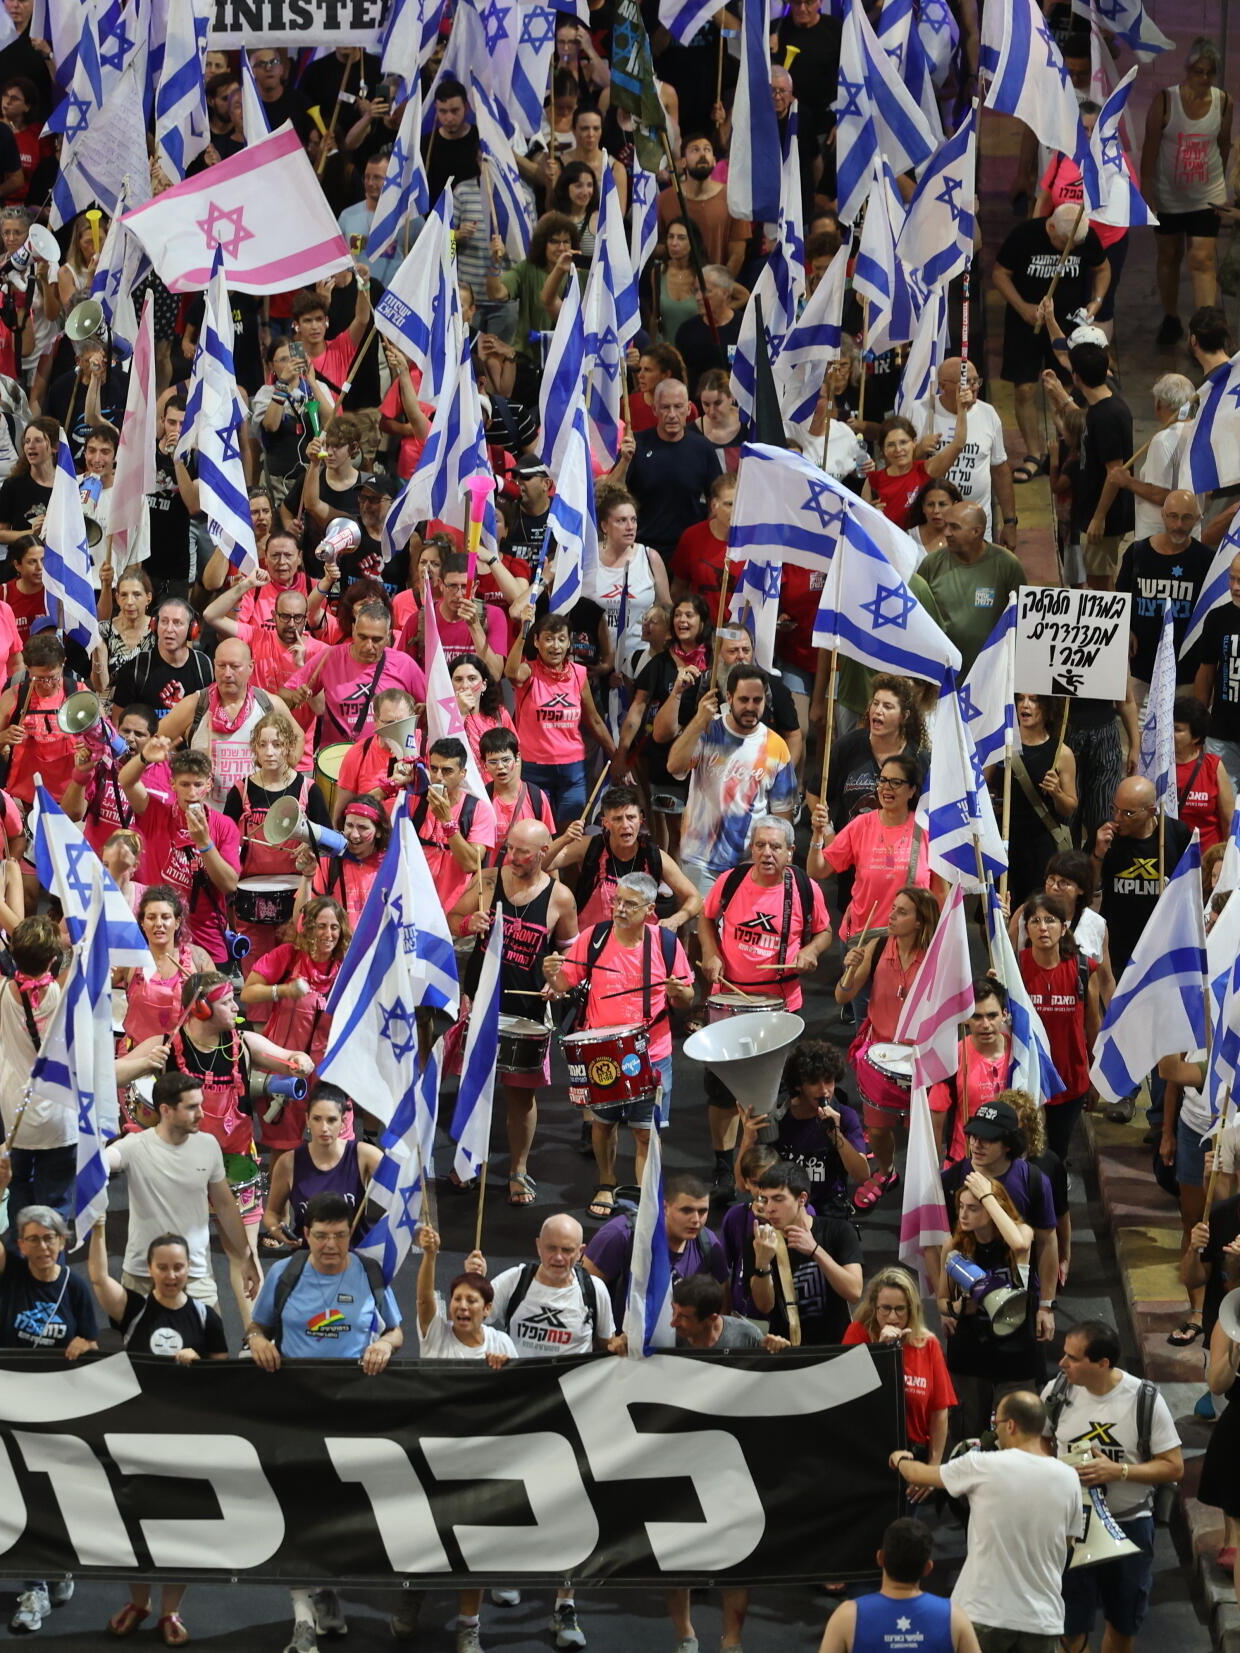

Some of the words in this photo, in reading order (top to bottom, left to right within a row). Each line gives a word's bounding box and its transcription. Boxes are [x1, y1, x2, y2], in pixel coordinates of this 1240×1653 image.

[212, 0, 390, 32] INISTE
[1022, 588, 1070, 622] חלקלק
[1137, 577, 1194, 601] חופשי
[1076, 592, 1126, 625] במדרון
[1187, 790, 1209, 801] מאב
[1051, 994, 1076, 1006] מאבק
[324, 1343, 882, 1573] לכו
